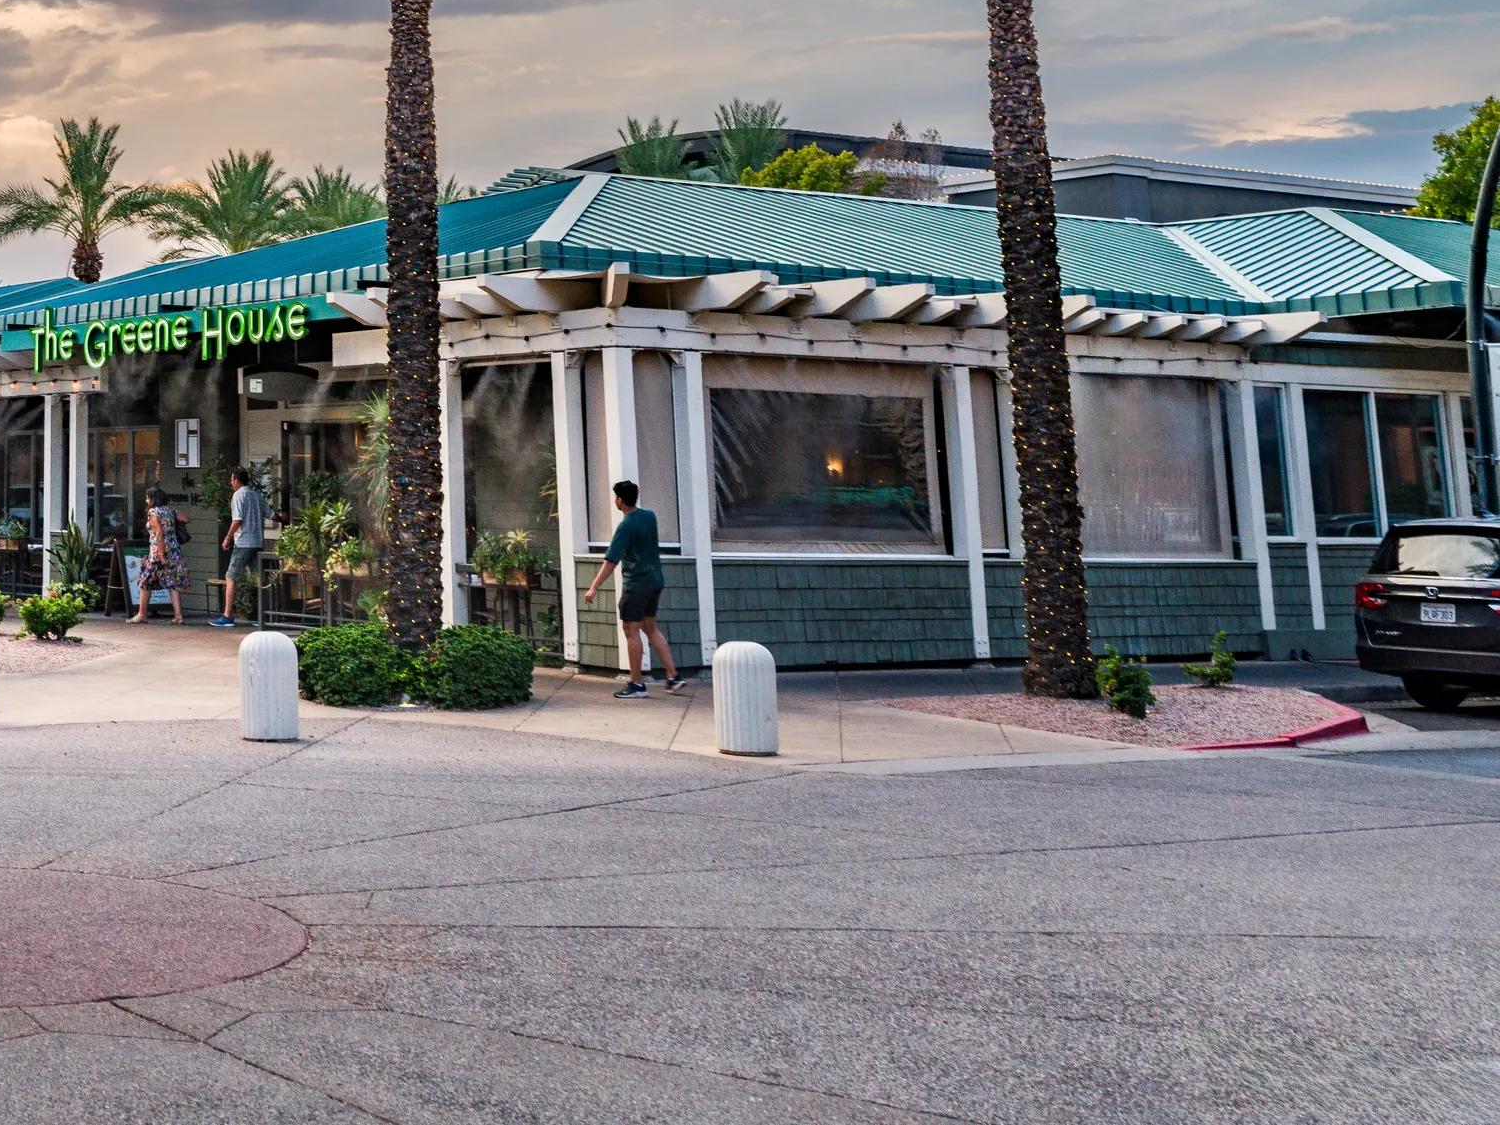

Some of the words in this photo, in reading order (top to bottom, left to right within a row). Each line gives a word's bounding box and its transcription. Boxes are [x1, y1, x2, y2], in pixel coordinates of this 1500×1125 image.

[30, 307, 76, 374] The
[83, 314, 189, 369] Greene
[201, 302, 309, 361] House
